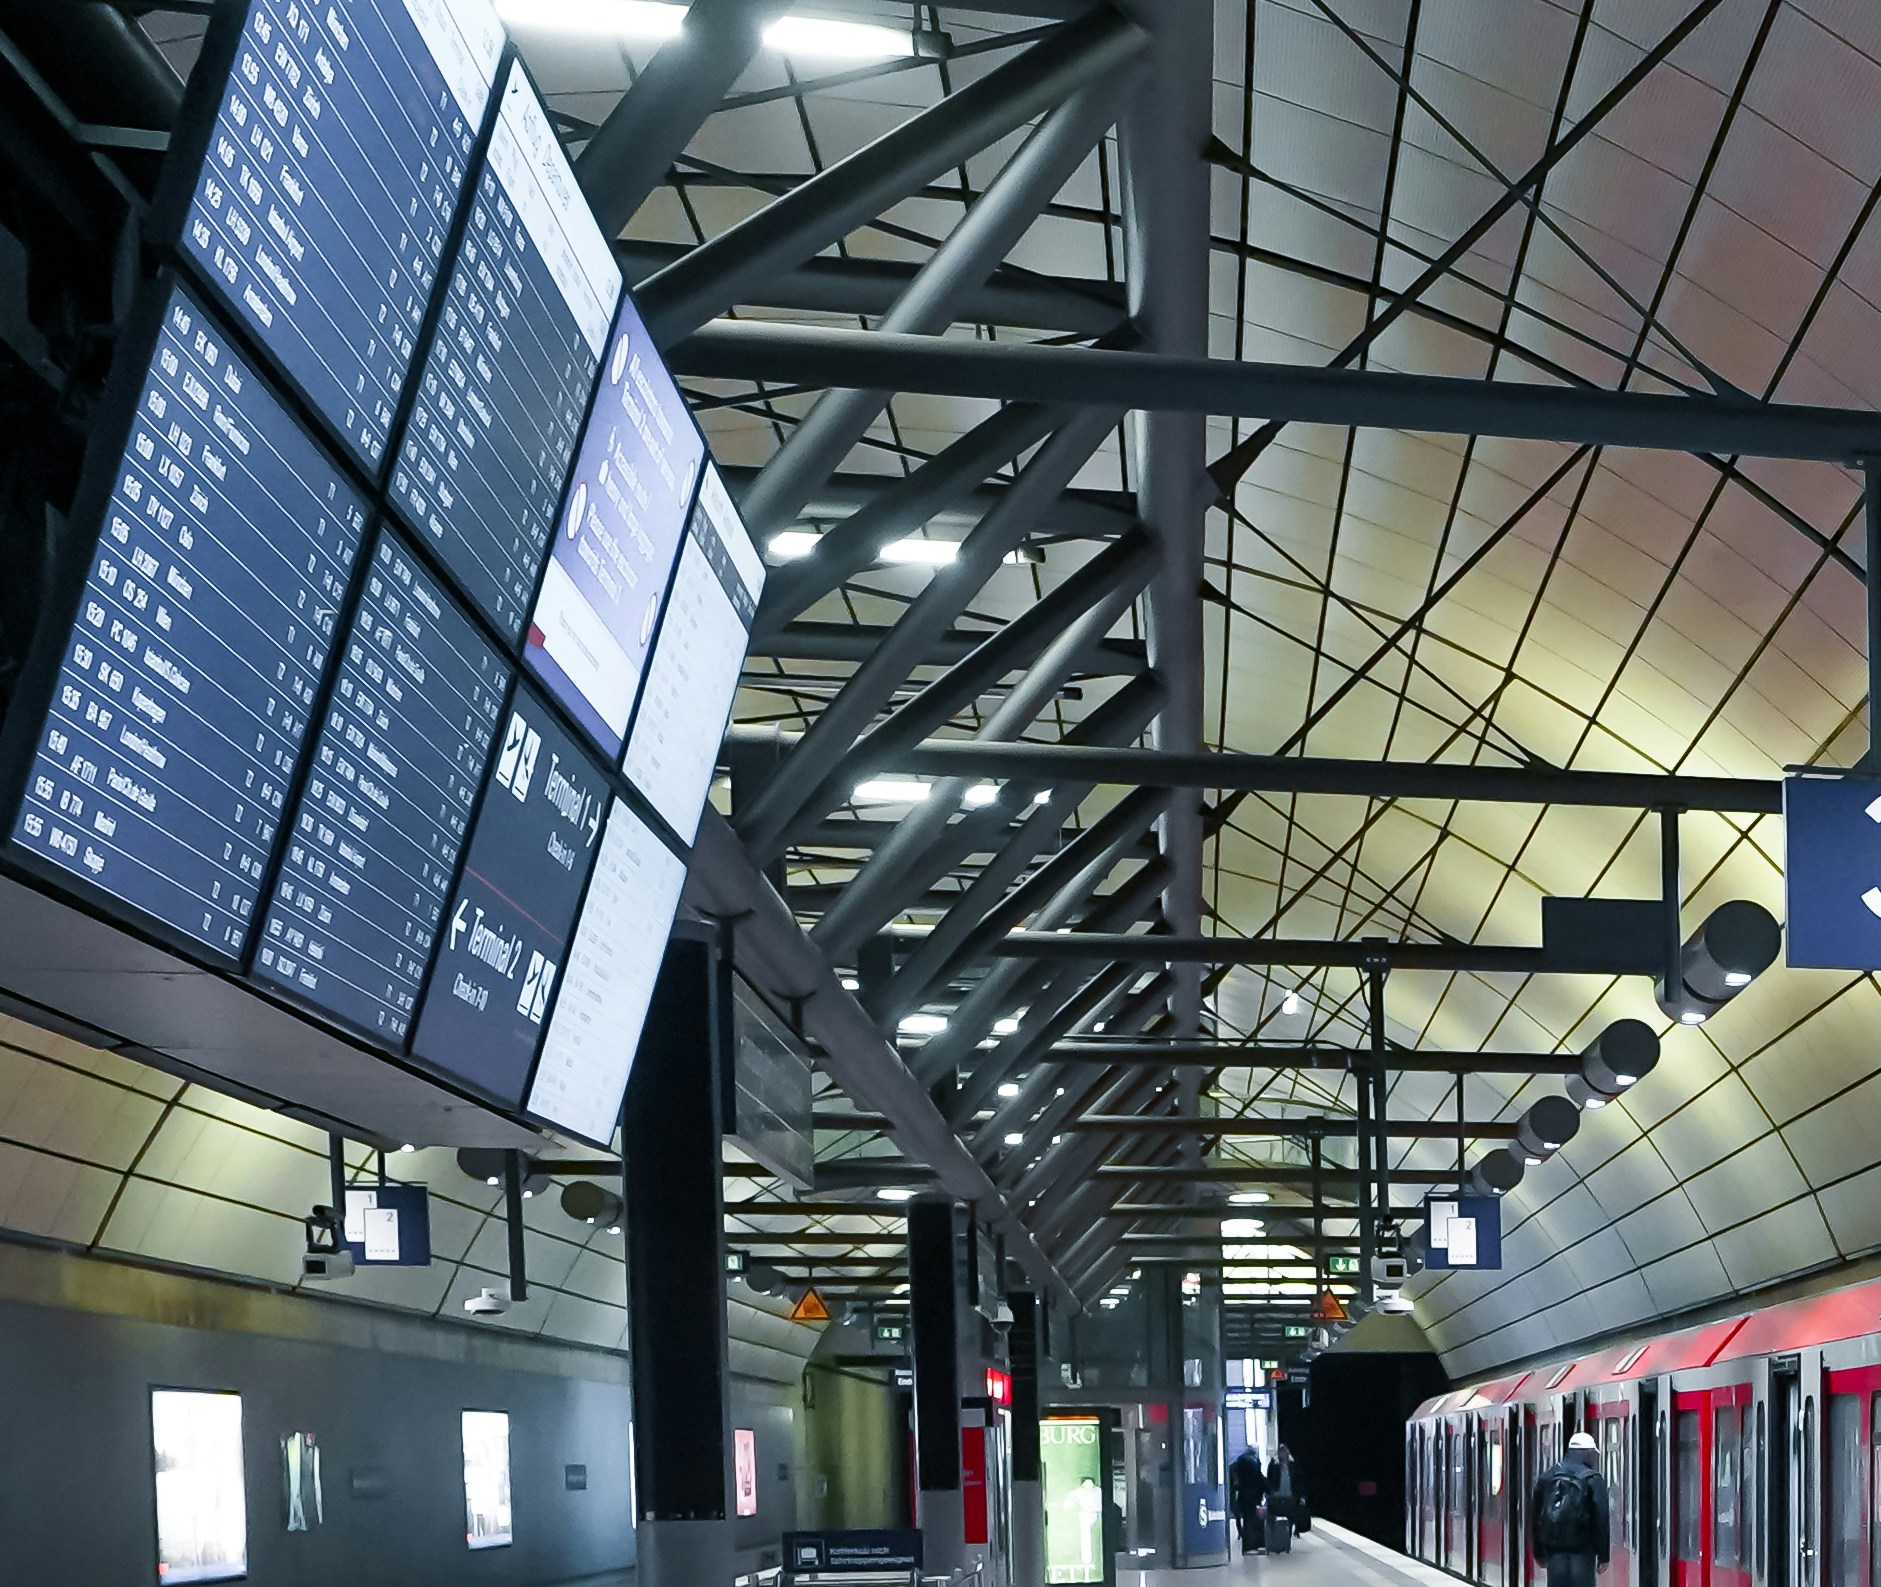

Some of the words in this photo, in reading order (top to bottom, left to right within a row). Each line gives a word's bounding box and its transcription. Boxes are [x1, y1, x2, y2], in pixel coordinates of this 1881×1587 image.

[545, 752, 586, 828] Terminal
[579, 794, 593, 831] 1
[464, 906, 516, 977] Terminal
[506, 937, 524, 982] 2
